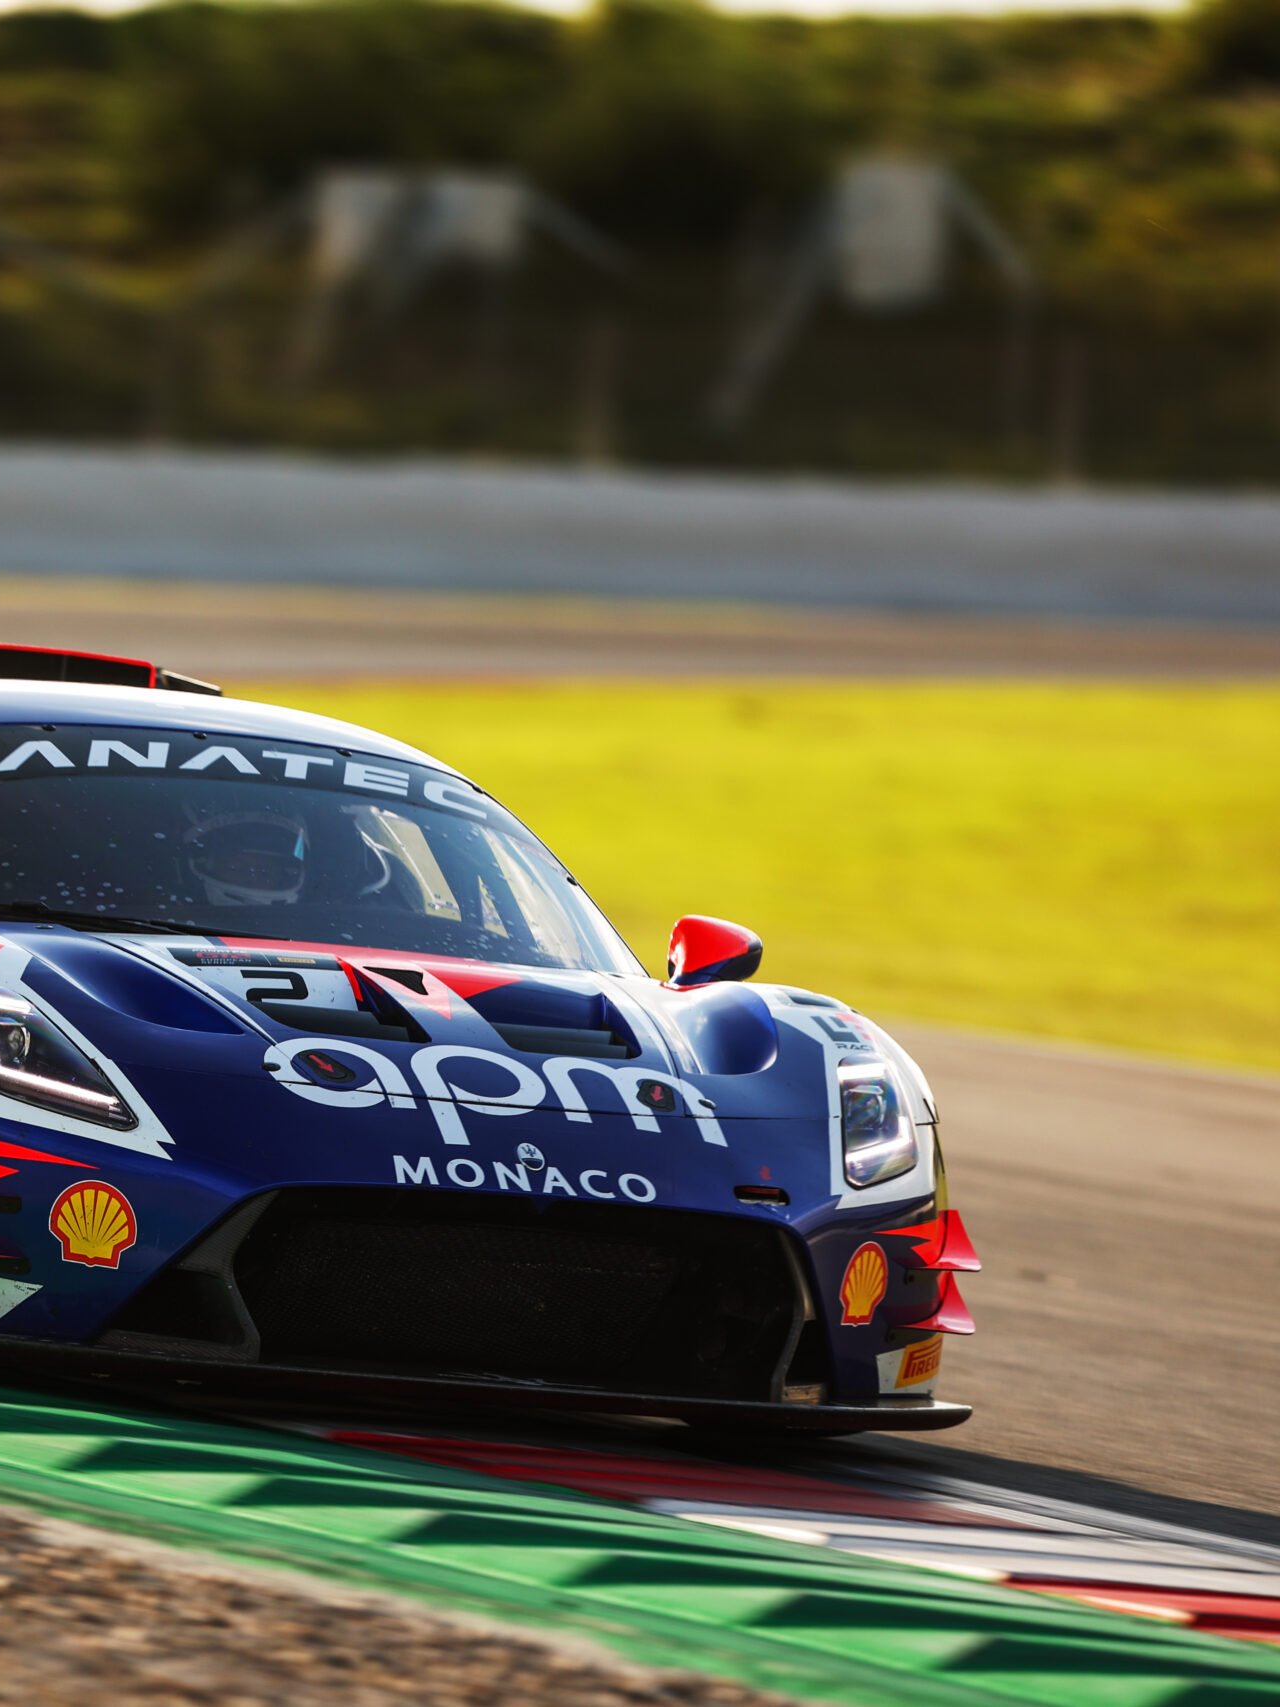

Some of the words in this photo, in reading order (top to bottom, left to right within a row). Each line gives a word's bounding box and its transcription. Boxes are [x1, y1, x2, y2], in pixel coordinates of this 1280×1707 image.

[240, 970, 309, 1003] 2
[263, 1037, 728, 1147] apm
[393, 1155, 657, 1203] MONACO
